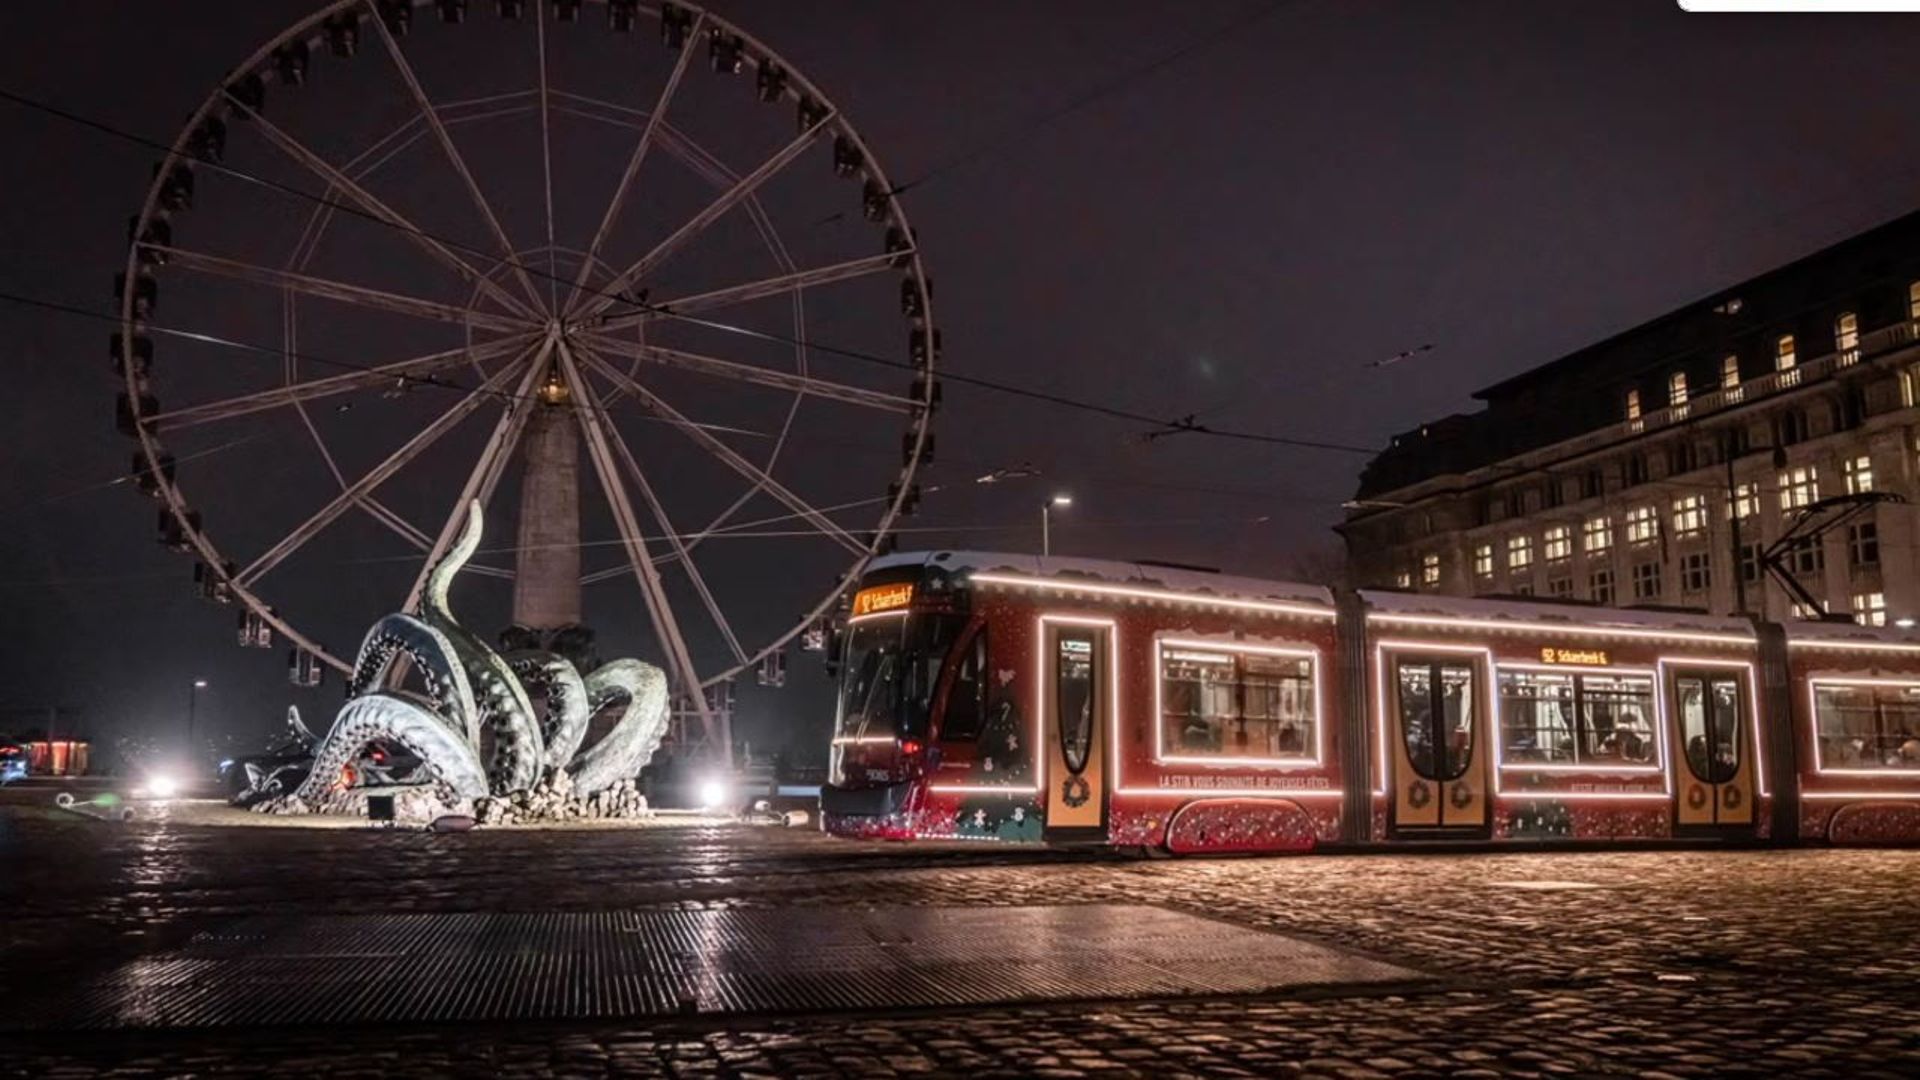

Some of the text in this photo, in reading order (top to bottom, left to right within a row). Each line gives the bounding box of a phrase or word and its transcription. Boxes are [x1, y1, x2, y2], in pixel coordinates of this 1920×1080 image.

[1159, 775, 1170, 788] LA
[1172, 775, 1191, 788] STIB
[1193, 775, 1213, 789] VOUS
[1257, 776, 1267, 789] DE
